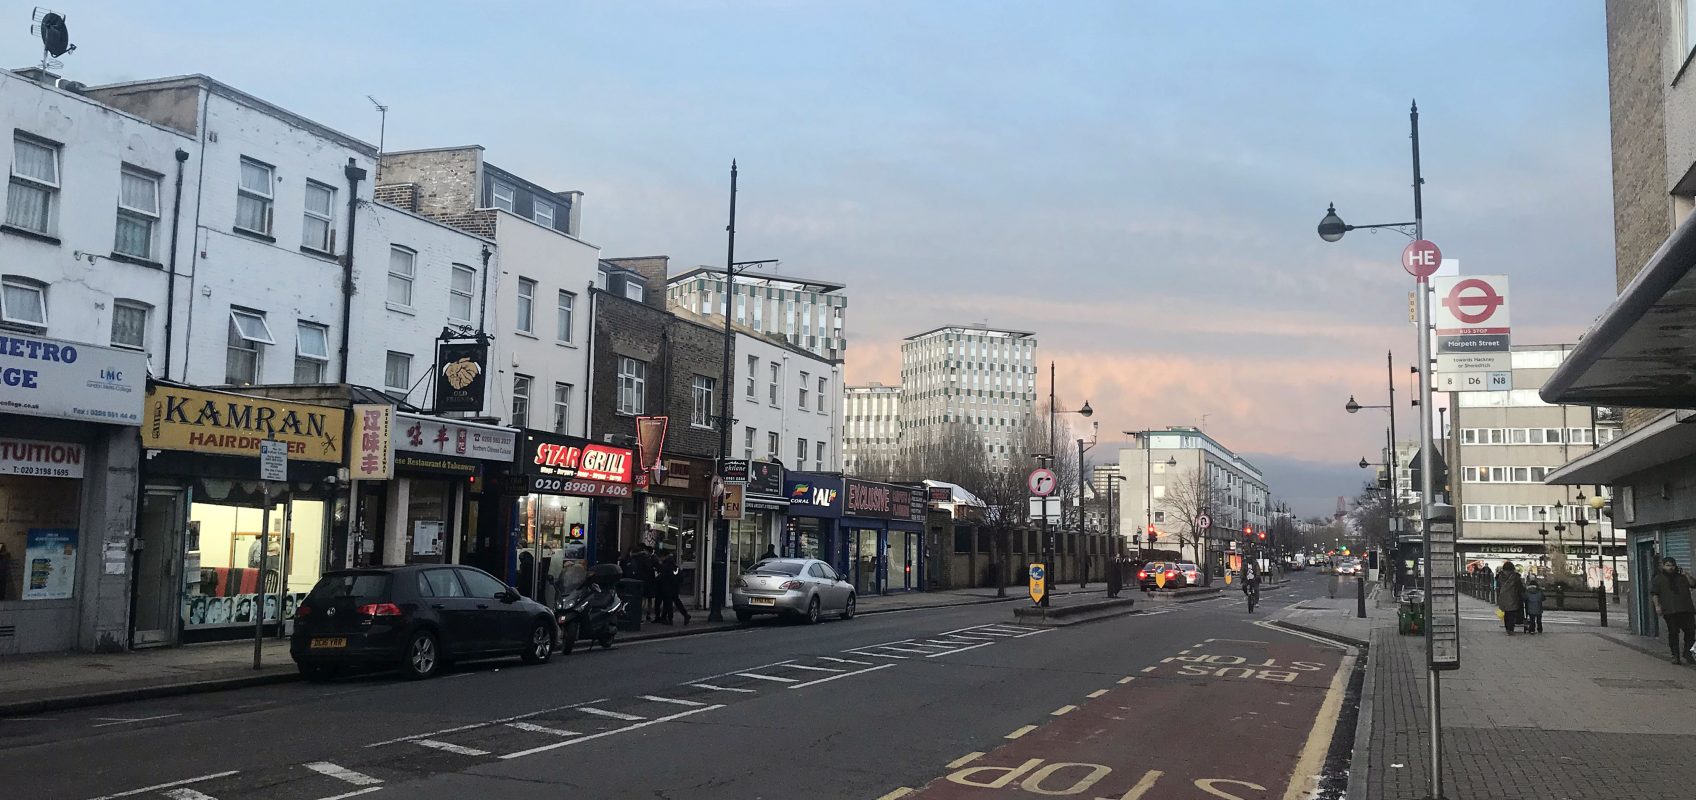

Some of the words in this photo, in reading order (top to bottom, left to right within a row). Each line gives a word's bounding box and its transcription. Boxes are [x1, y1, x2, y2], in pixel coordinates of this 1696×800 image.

[1409, 250, 1435, 266] HE
[1448, 340, 1477, 349] Morpeth
[1478, 339, 1500, 347] Street
[0, 367, 38, 389] GE
[101, 369, 123, 381] LMC
[1468, 377, 1481, 385] D6
[1493, 377, 1506, 385] N8
[164, 395, 327, 438] KAMRAN
[189, 431, 307, 454] HAIRDRER
[0, 442, 80, 465] TUITION
[534, 443, 581, 469] STAR
[582, 449, 625, 474] GRILL
[20, 466, 34, 474] 020
[34, 467, 52, 475] 3198
[53, 468, 69, 476] 1695
[407, 457, 442, 468] Restaurant
[447, 461, 476, 473] Takeaway
[535, 479, 560, 490] 020
[563, 481, 595, 493] 8980
[600, 485, 628, 496] 1406
[848, 484, 889, 512] EXCLUSIVE
[713, 502, 740, 512] EEN
[1175, 654, 1326, 671] STOP
[1177, 665, 1299, 682] BUS
